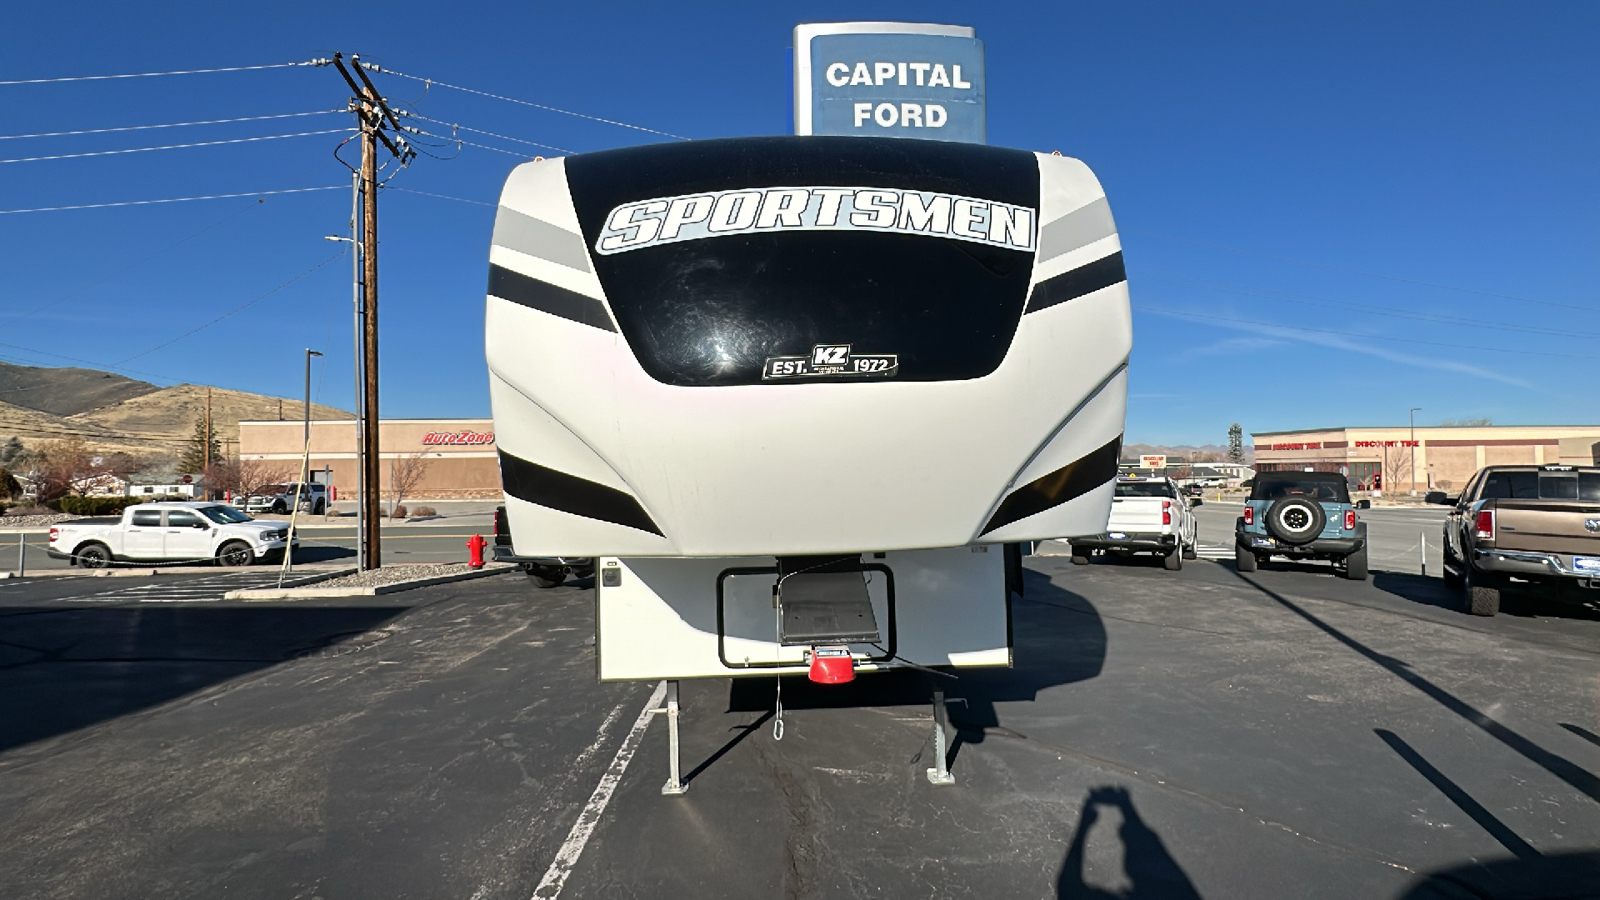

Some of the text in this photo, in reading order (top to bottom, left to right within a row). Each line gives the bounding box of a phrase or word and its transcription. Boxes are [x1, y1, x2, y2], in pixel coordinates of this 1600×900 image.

[826, 62, 971, 89] CAPITAL
[854, 102, 948, 128] FORD
[598, 187, 1034, 251] SPORTSMEN
[814, 347, 848, 364] KZ
[772, 360, 808, 375] EST.
[853, 359, 888, 373] 1972
[423, 431, 494, 444] AutoZone
[1355, 440, 1419, 448] DISCOUNT TIRE
